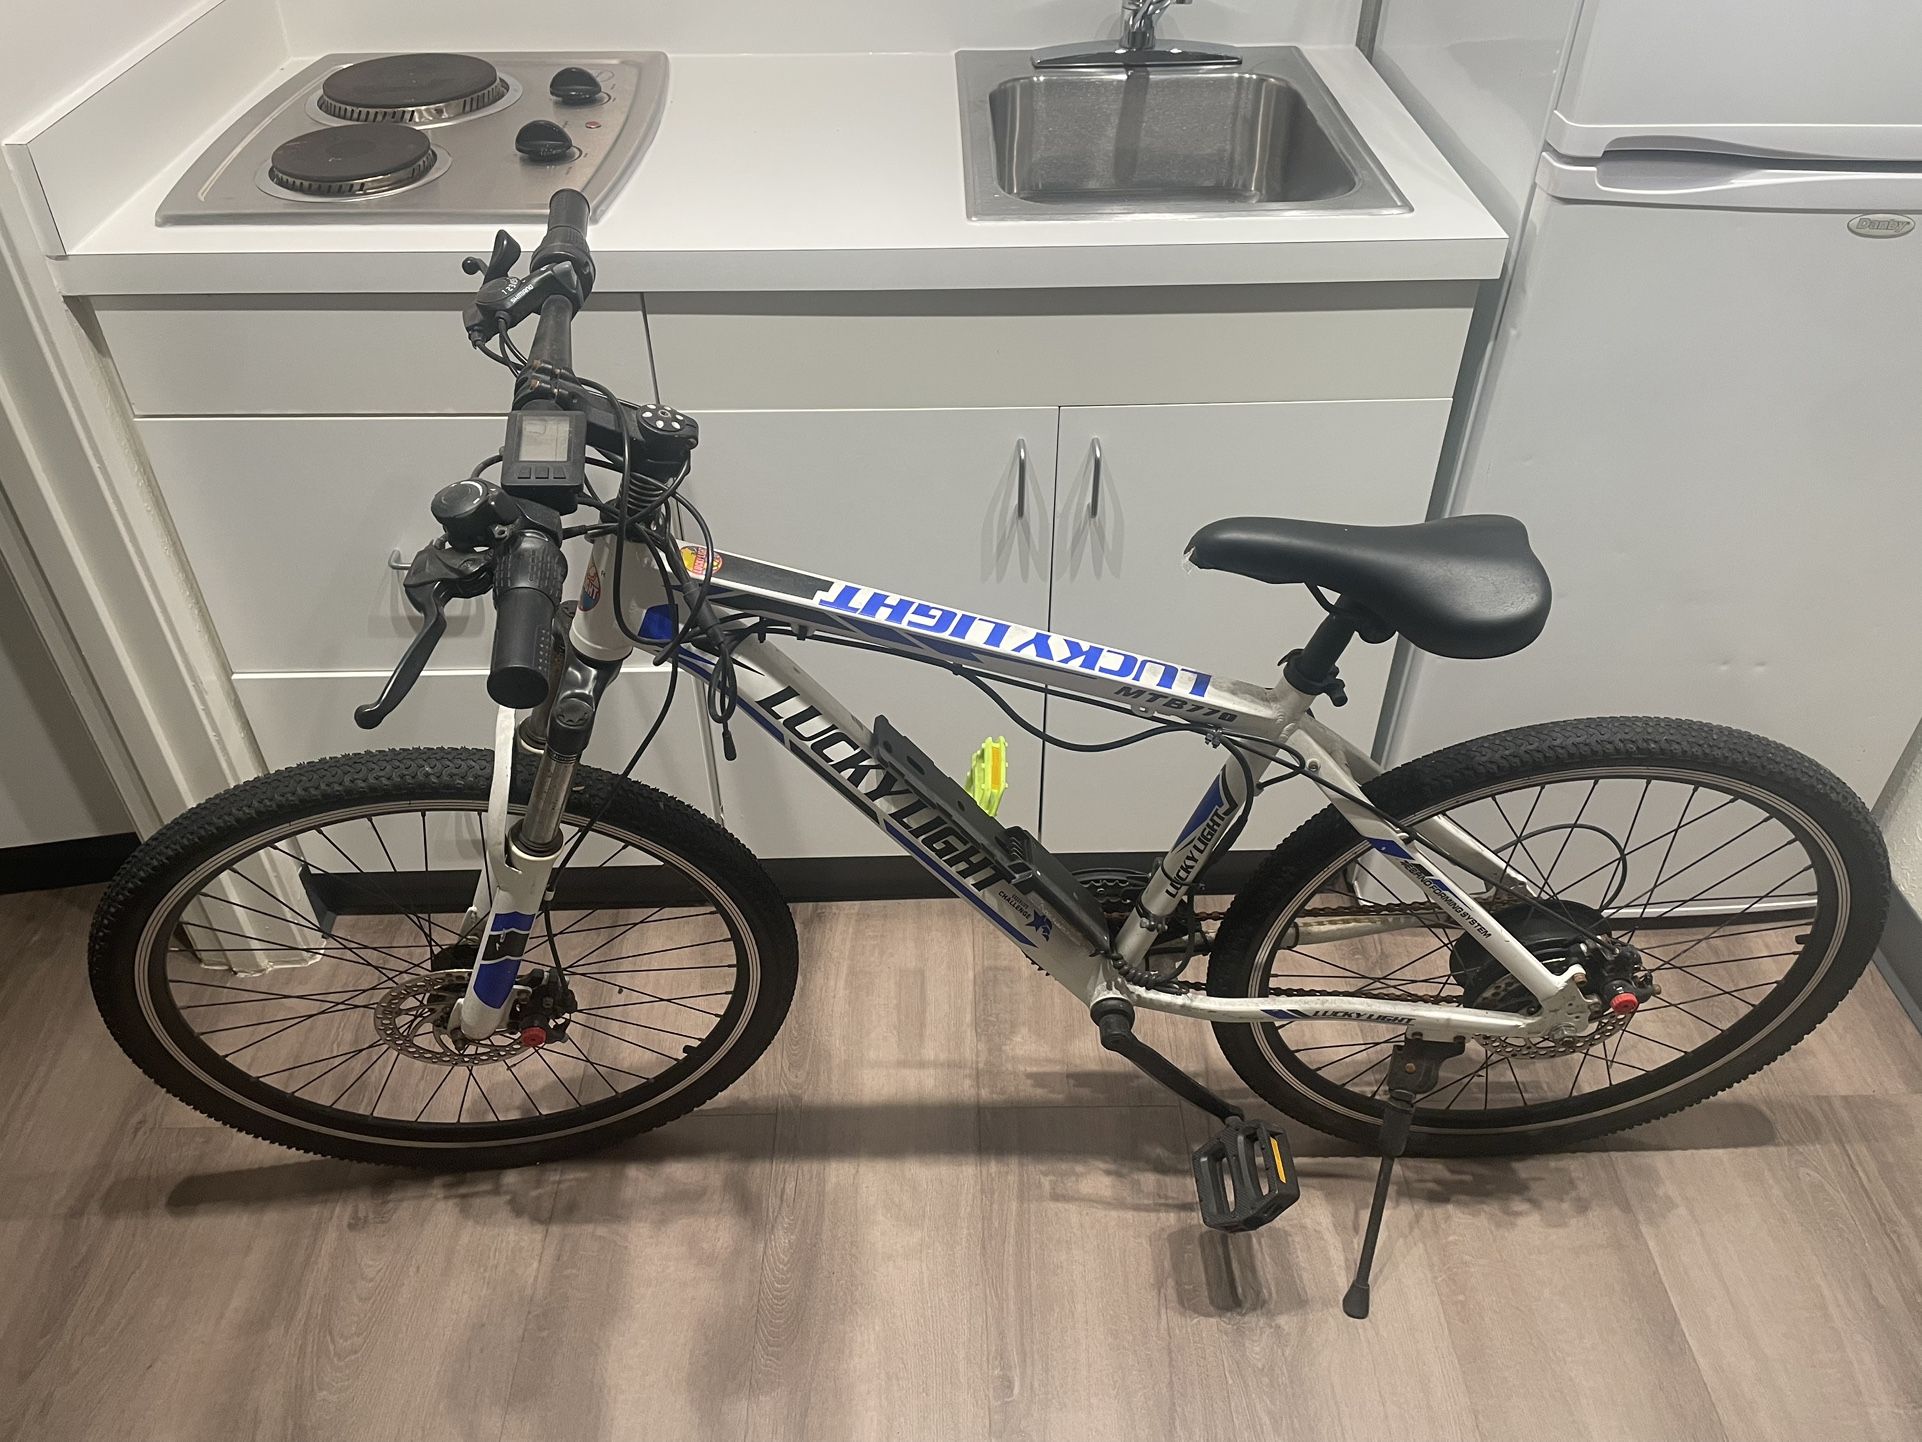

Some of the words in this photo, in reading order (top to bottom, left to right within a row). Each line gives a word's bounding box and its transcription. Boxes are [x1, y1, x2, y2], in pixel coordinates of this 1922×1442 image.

[1856, 217, 1907, 233] Danby
[819, 584, 1010, 648] LIGHT
[1013, 632, 1212, 698] LUCKY
[998, 890, 1032, 920] CHALLENGE
[1429, 882, 1464, 914] FORMING
[1460, 910, 1492, 939] SYSTEM
